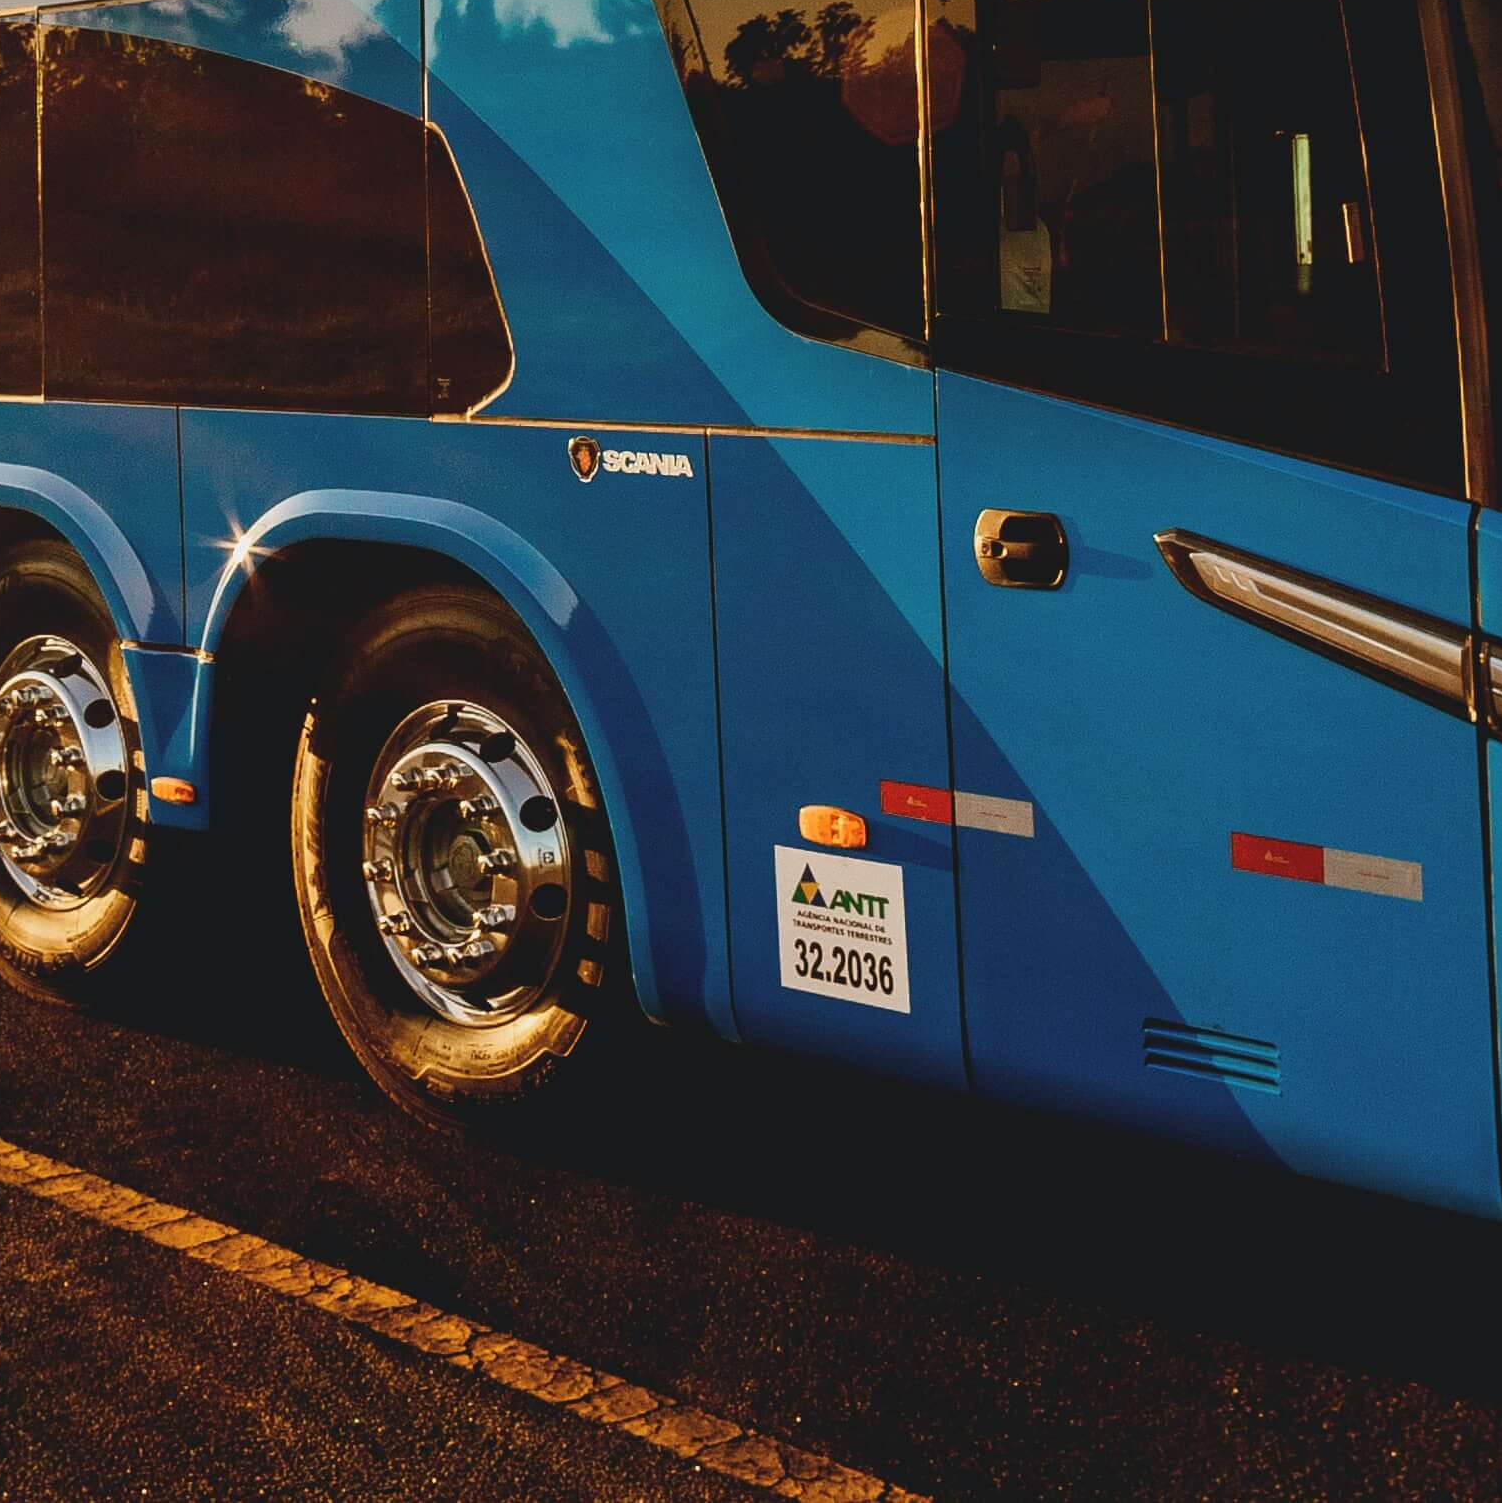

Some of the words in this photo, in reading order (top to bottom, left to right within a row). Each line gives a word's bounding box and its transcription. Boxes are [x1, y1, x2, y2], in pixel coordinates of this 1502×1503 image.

[602, 449, 694, 478] SCANIA
[828, 889, 890, 920] ANTT
[792, 918, 845, 937] TRANSPORTES
[847, 929, 893, 946] TERRESTRES
[833, 916, 874, 931] NACIONAL
[875, 924, 886, 933] DE
[794, 937, 895, 996] 32.2036
